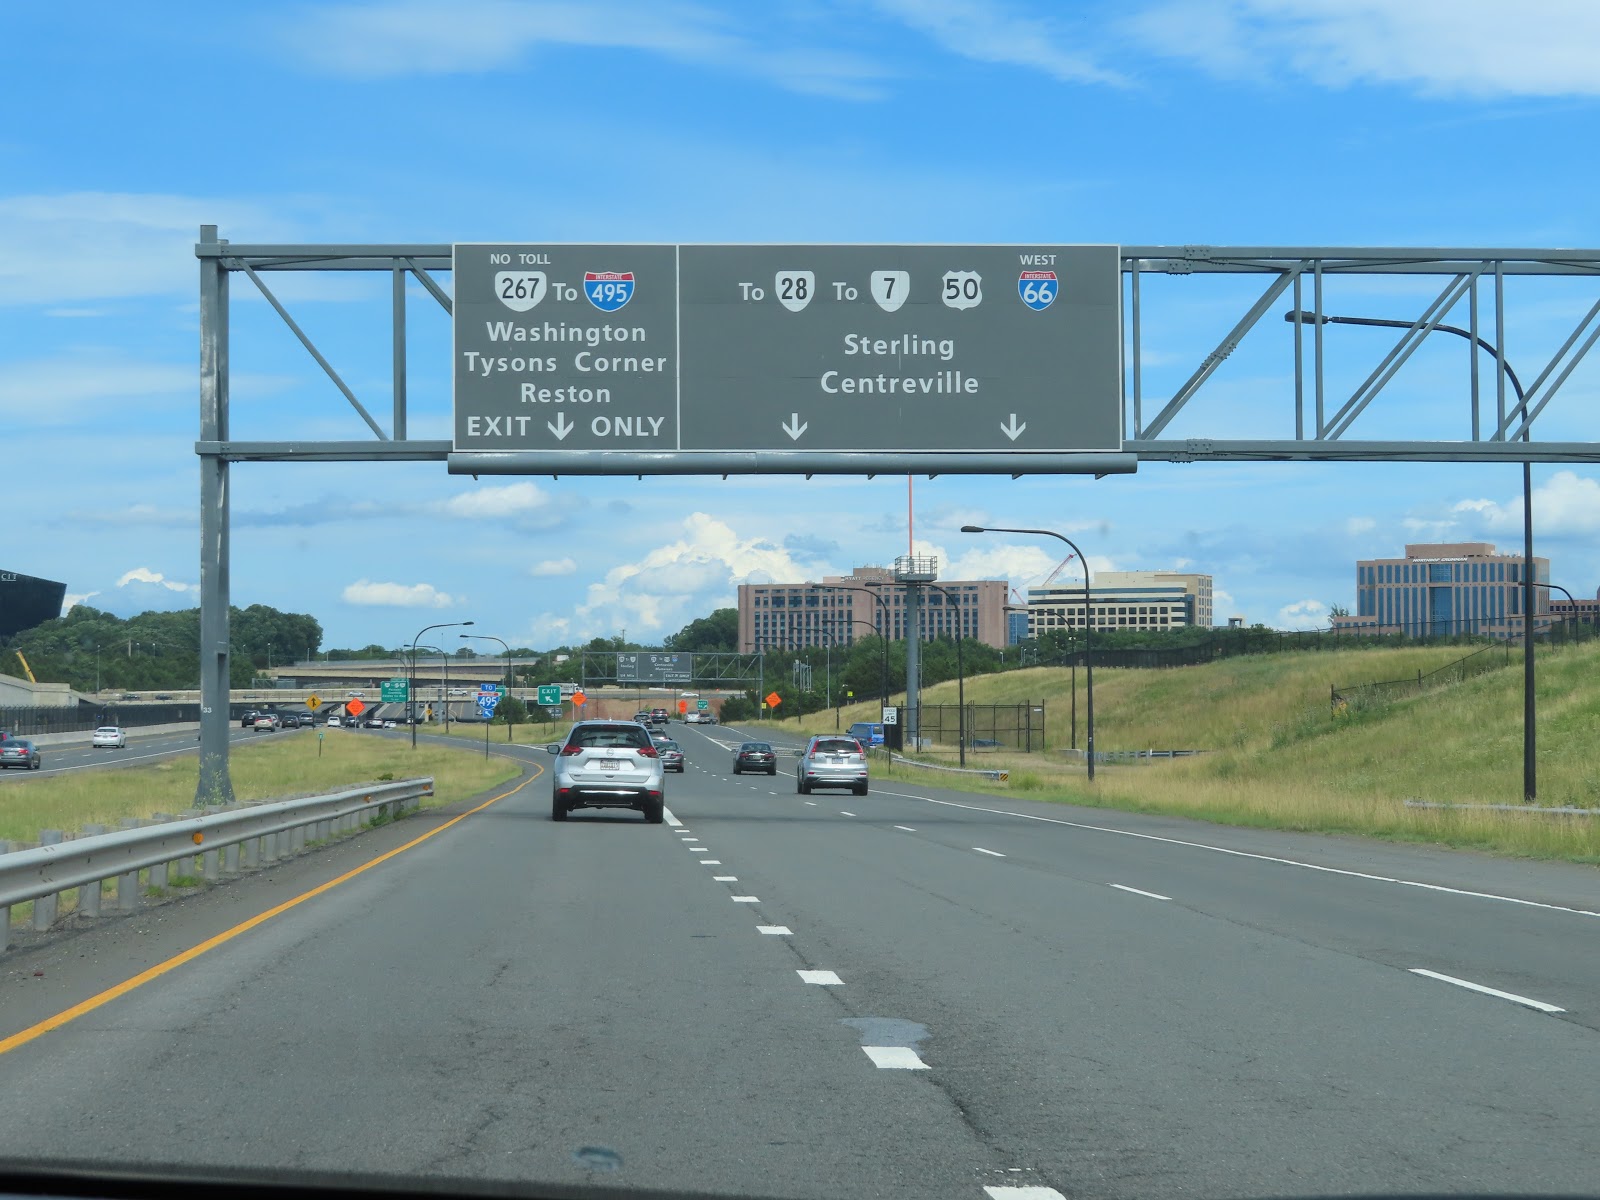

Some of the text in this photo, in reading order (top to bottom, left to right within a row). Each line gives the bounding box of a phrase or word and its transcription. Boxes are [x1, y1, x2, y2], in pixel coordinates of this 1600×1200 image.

[490, 254, 551, 265] NO TOLL
[1019, 254, 1057, 266] WEST
[501, 277, 540, 299] 267
[552, 282, 578, 301] To
[591, 283, 628, 303] 495
[738, 282, 765, 301] To
[780, 277, 808, 300] 28
[832, 282, 858, 301] To
[883, 277, 896, 300] 7
[945, 278, 979, 300] 50
[1023, 281, 1053, 304] 66
[486, 321, 646, 347] Washington
[843, 333, 954, 360] Sterling
[463, 351, 667, 377] Tysons Corner
[521, 382, 611, 403] Reston
[820, 370, 979, 394] Centreville
[467, 416, 665, 437] EXIT ONLY
[479, 696, 497, 706] 495
